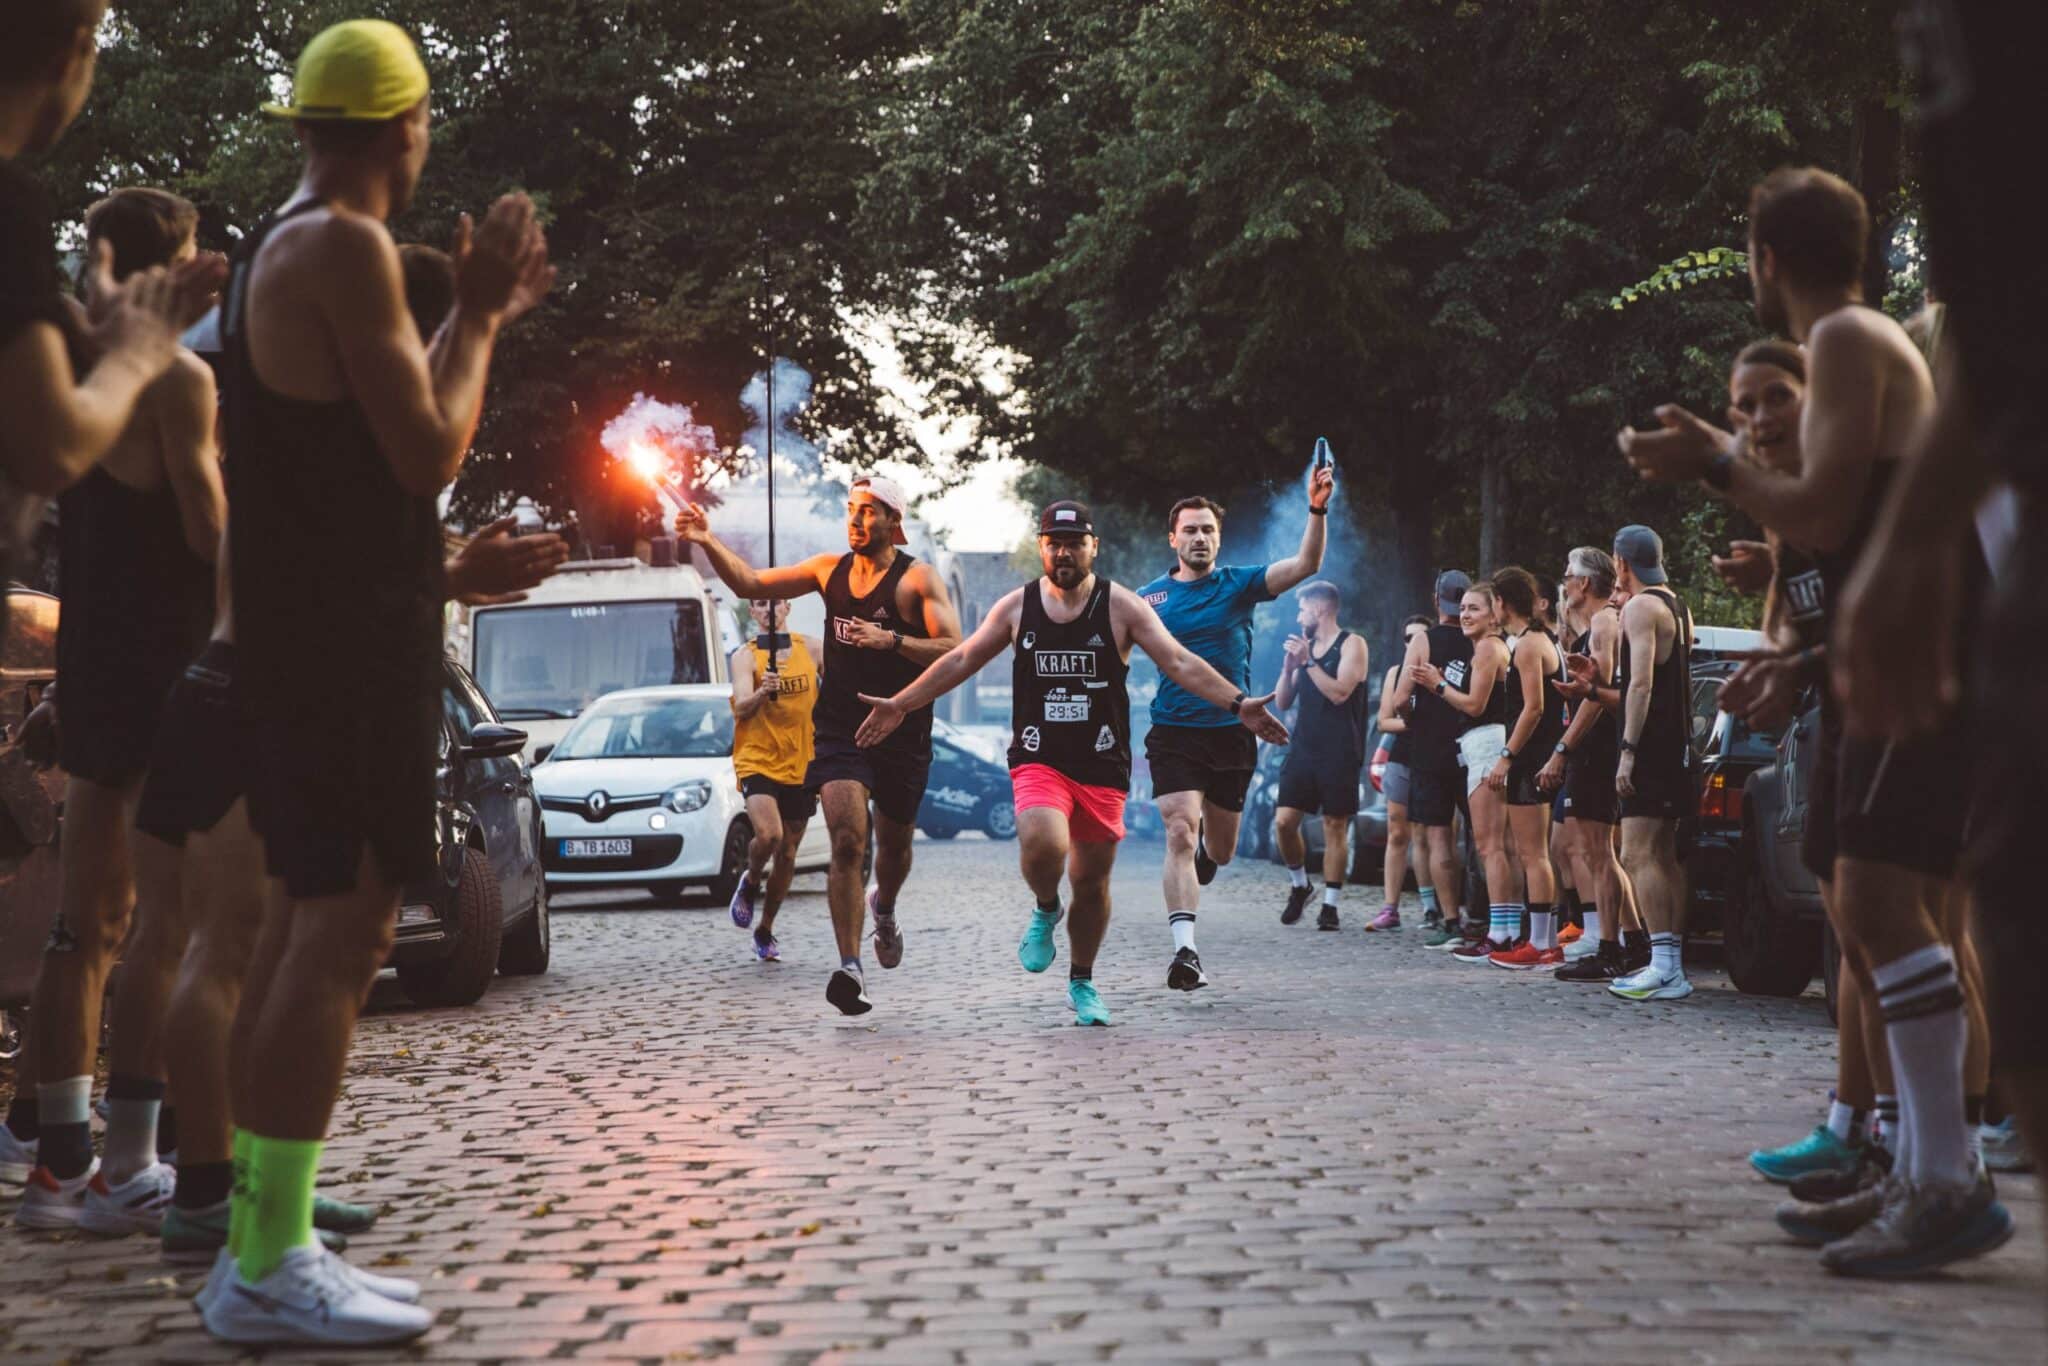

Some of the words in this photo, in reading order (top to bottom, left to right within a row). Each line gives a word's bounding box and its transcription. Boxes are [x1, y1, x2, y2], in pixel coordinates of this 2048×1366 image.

[1039, 655, 1092, 673] KRAFT.
[1048, 705, 1084, 719] 29:51
[600, 840, 630, 854] 1603
